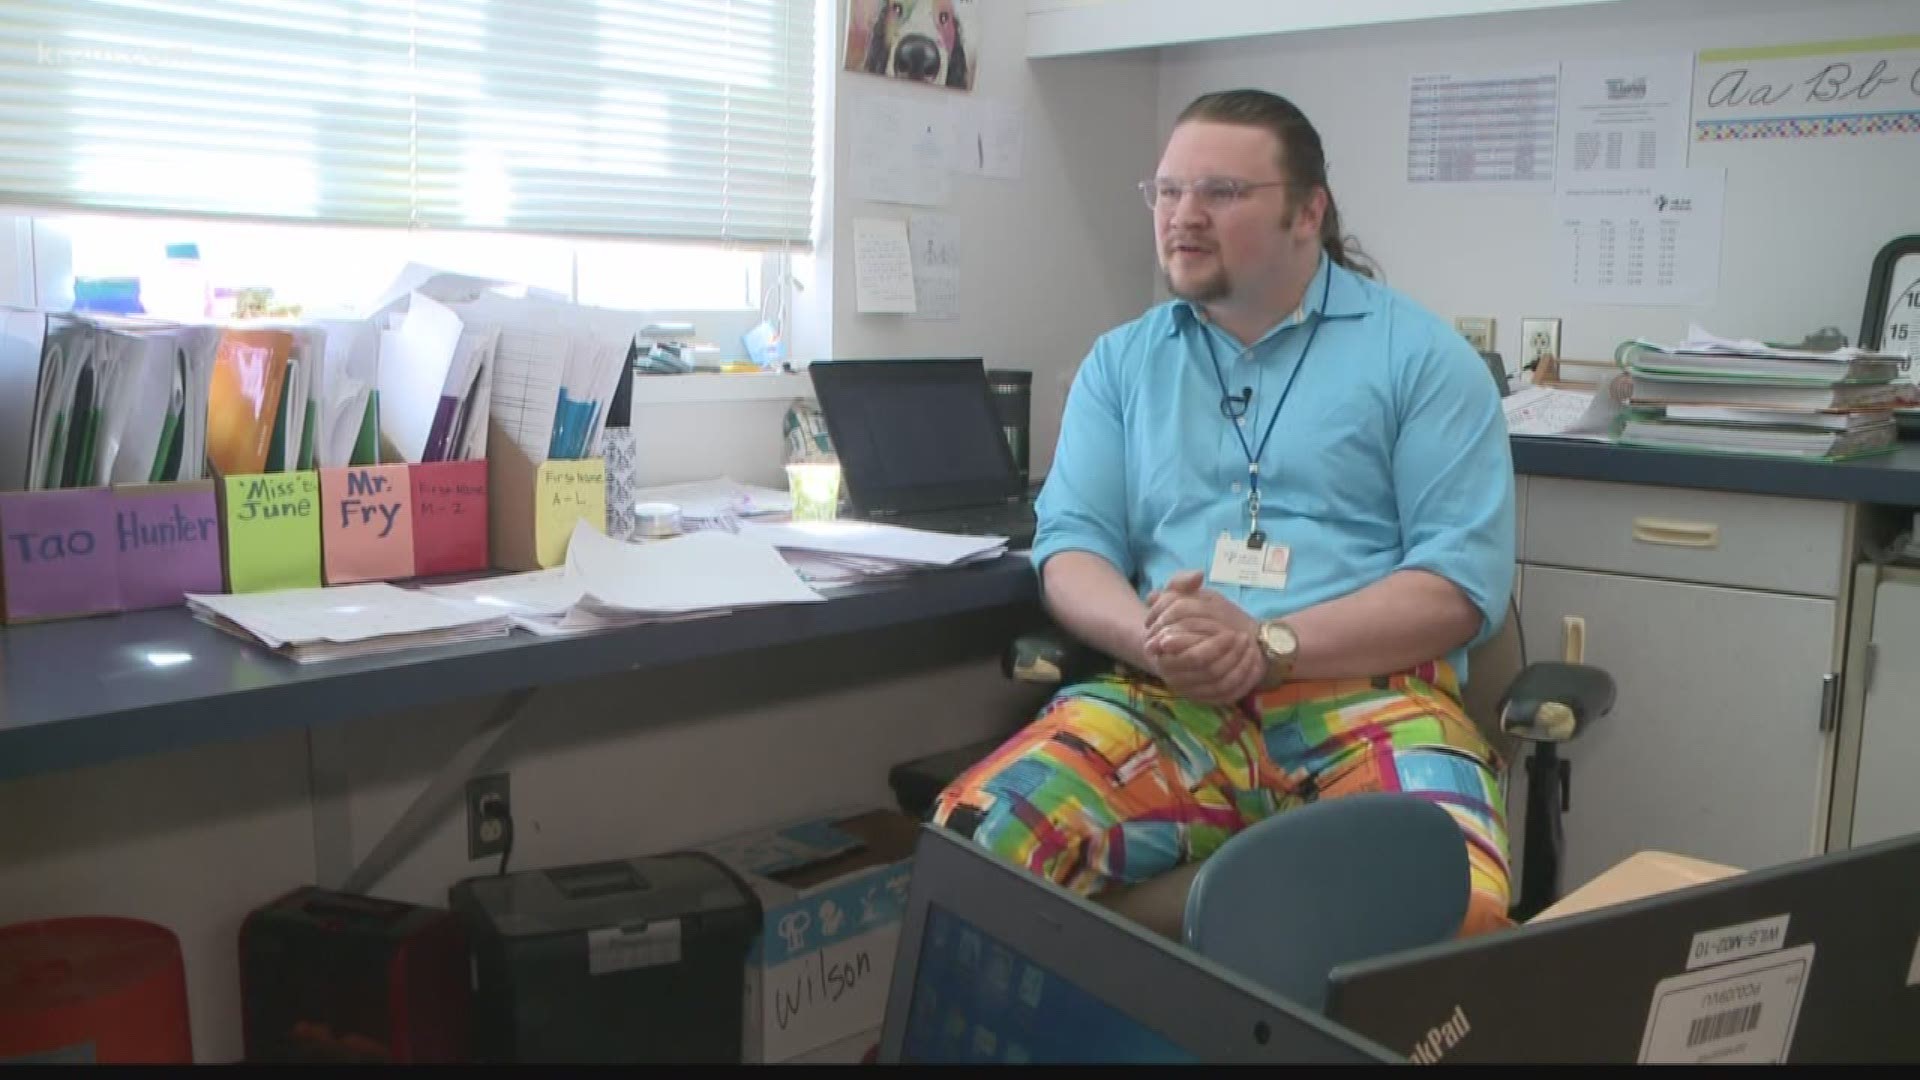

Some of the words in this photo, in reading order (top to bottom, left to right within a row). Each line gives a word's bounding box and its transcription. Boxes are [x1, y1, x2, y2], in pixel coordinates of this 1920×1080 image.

[1708, 68, 1794, 108] Aa
[1804, 59, 1899, 102] Bb
[1890, 324, 1909, 340] 15
[347, 470, 393, 497] Mr.
[237, 498, 311, 521] June
[341, 499, 402, 539] Fry
[115, 503, 216, 552] Hunter
[8, 529, 97, 563] Tao
